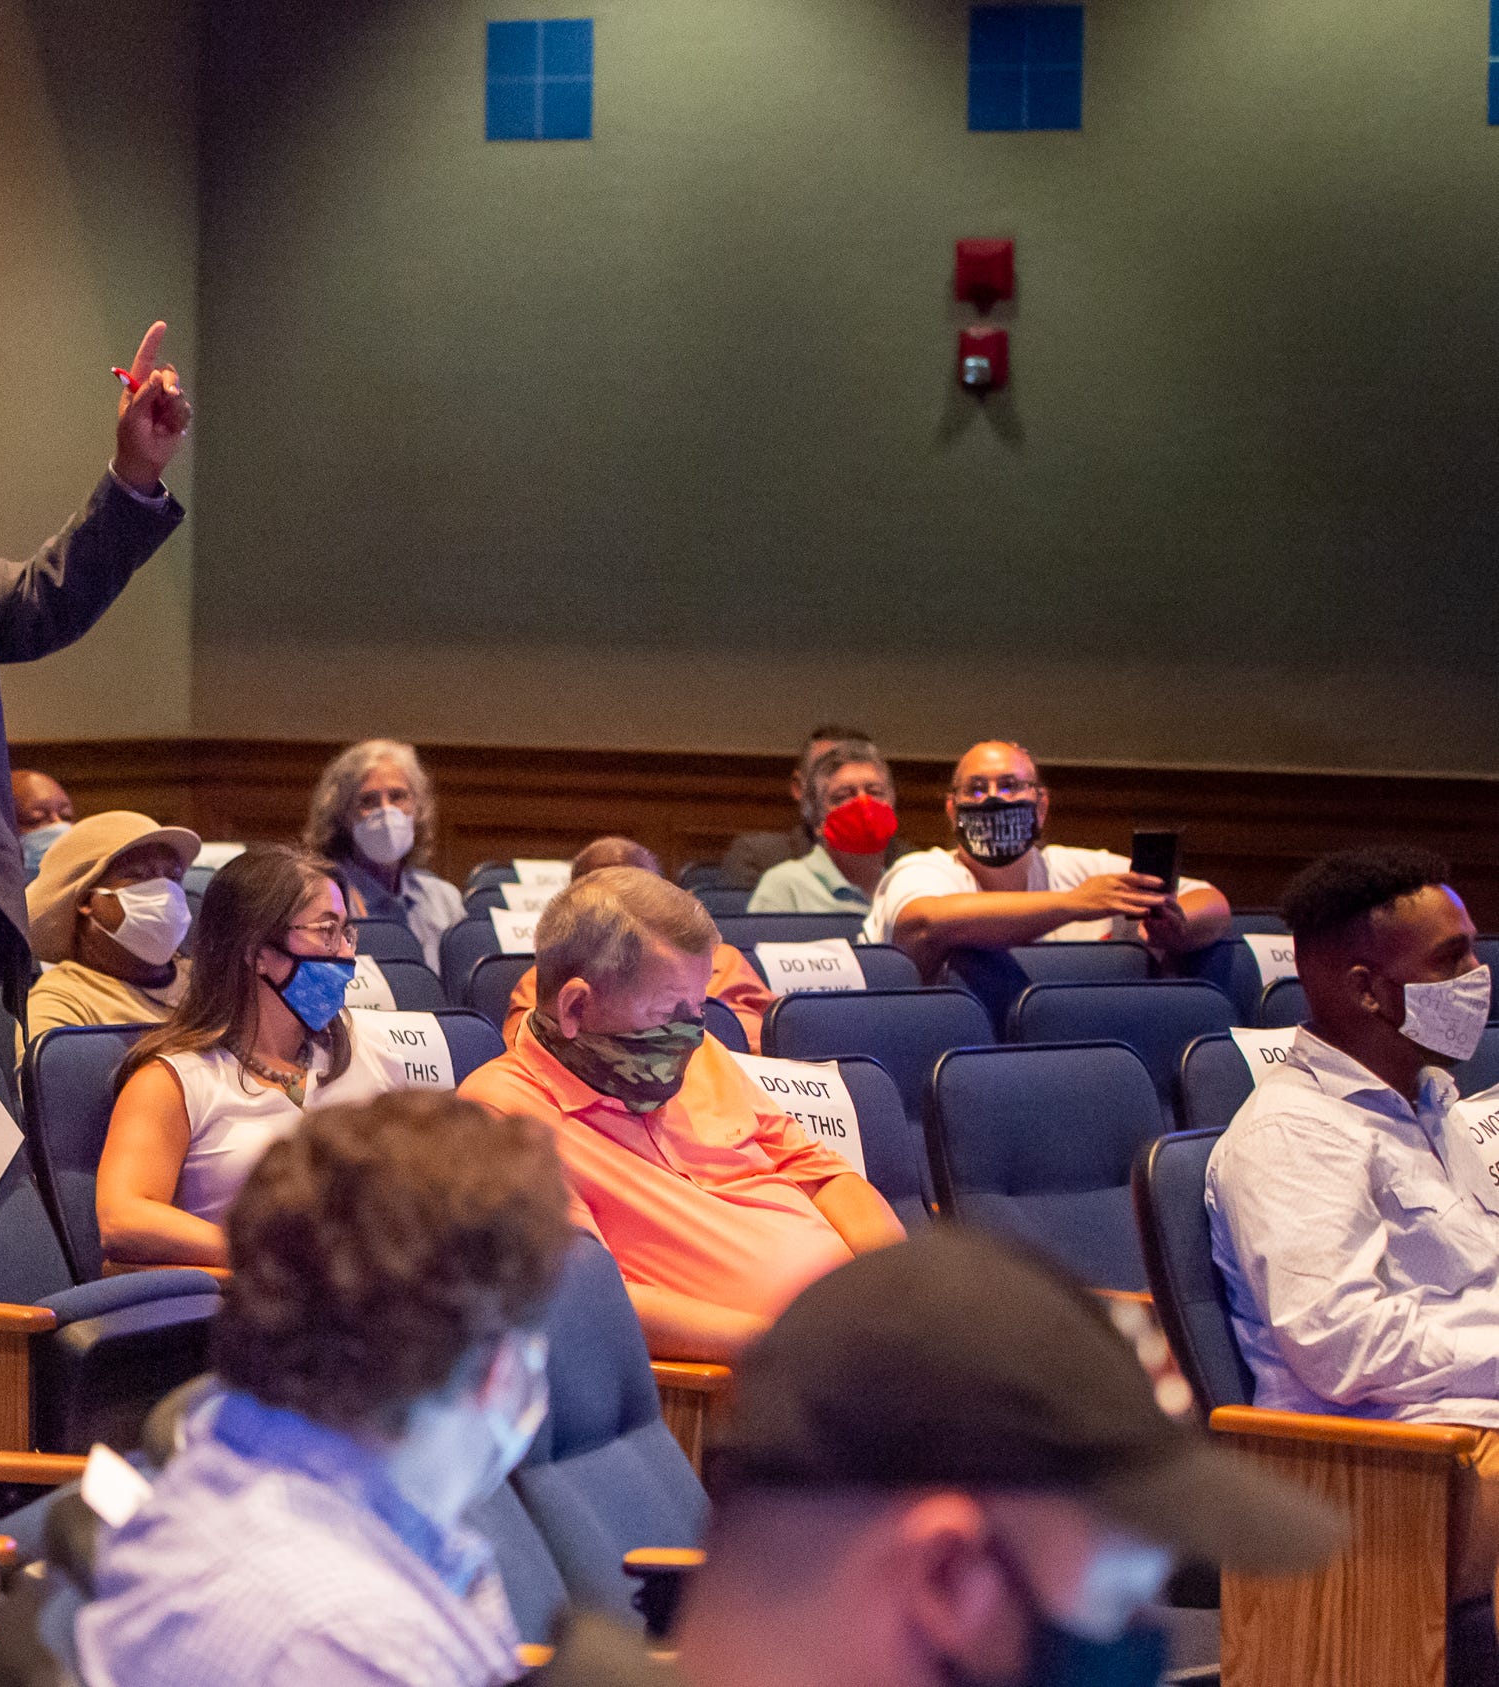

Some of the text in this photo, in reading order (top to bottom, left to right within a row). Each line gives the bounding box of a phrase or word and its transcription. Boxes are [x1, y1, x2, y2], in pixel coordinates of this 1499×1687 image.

[1271, 949, 1294, 962] DO
[779, 958, 841, 973] DO NOT
[345, 976, 369, 990] OT
[389, 1029, 427, 1047] NOT
[1259, 1047, 1287, 1064] DO
[404, 1062, 439, 1082] THIS
[760, 1075, 831, 1099] DO NOT
[808, 1114, 846, 1138] THIS
[1478, 1111, 1499, 1139] NO
